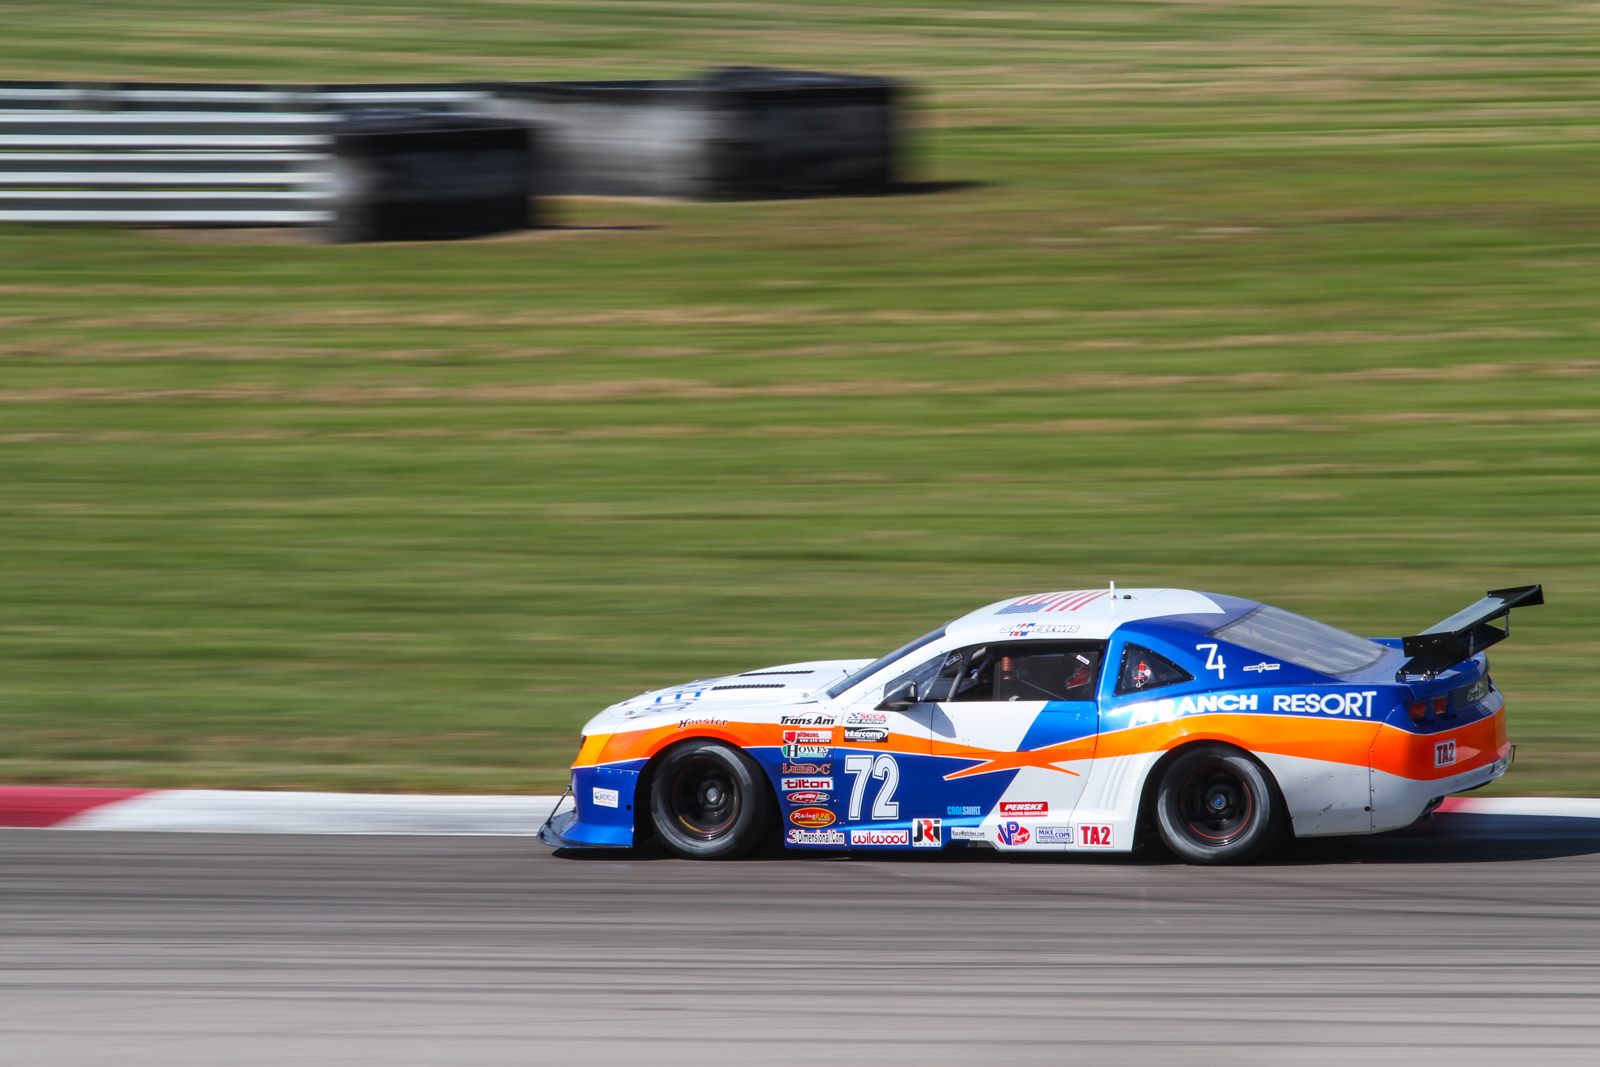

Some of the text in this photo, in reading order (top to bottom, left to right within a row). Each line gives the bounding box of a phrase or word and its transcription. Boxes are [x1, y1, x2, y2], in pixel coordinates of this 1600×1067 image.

[1158, 694, 1258, 721] RANCH
[1273, 691, 1378, 717] RESORT
[675, 717, 729, 729] Hoosier
[780, 715, 835, 725] Trans Am
[844, 729, 884, 740] Intercomp
[1436, 743, 1455, 765] TA2
[784, 779, 830, 789] tilton
[844, 754, 900, 820] 72
[1004, 803, 1044, 811] PENSKE
[852, 831, 908, 844] wilwood
[997, 820, 1020, 846] VP
[1081, 826, 1111, 845] TA2
